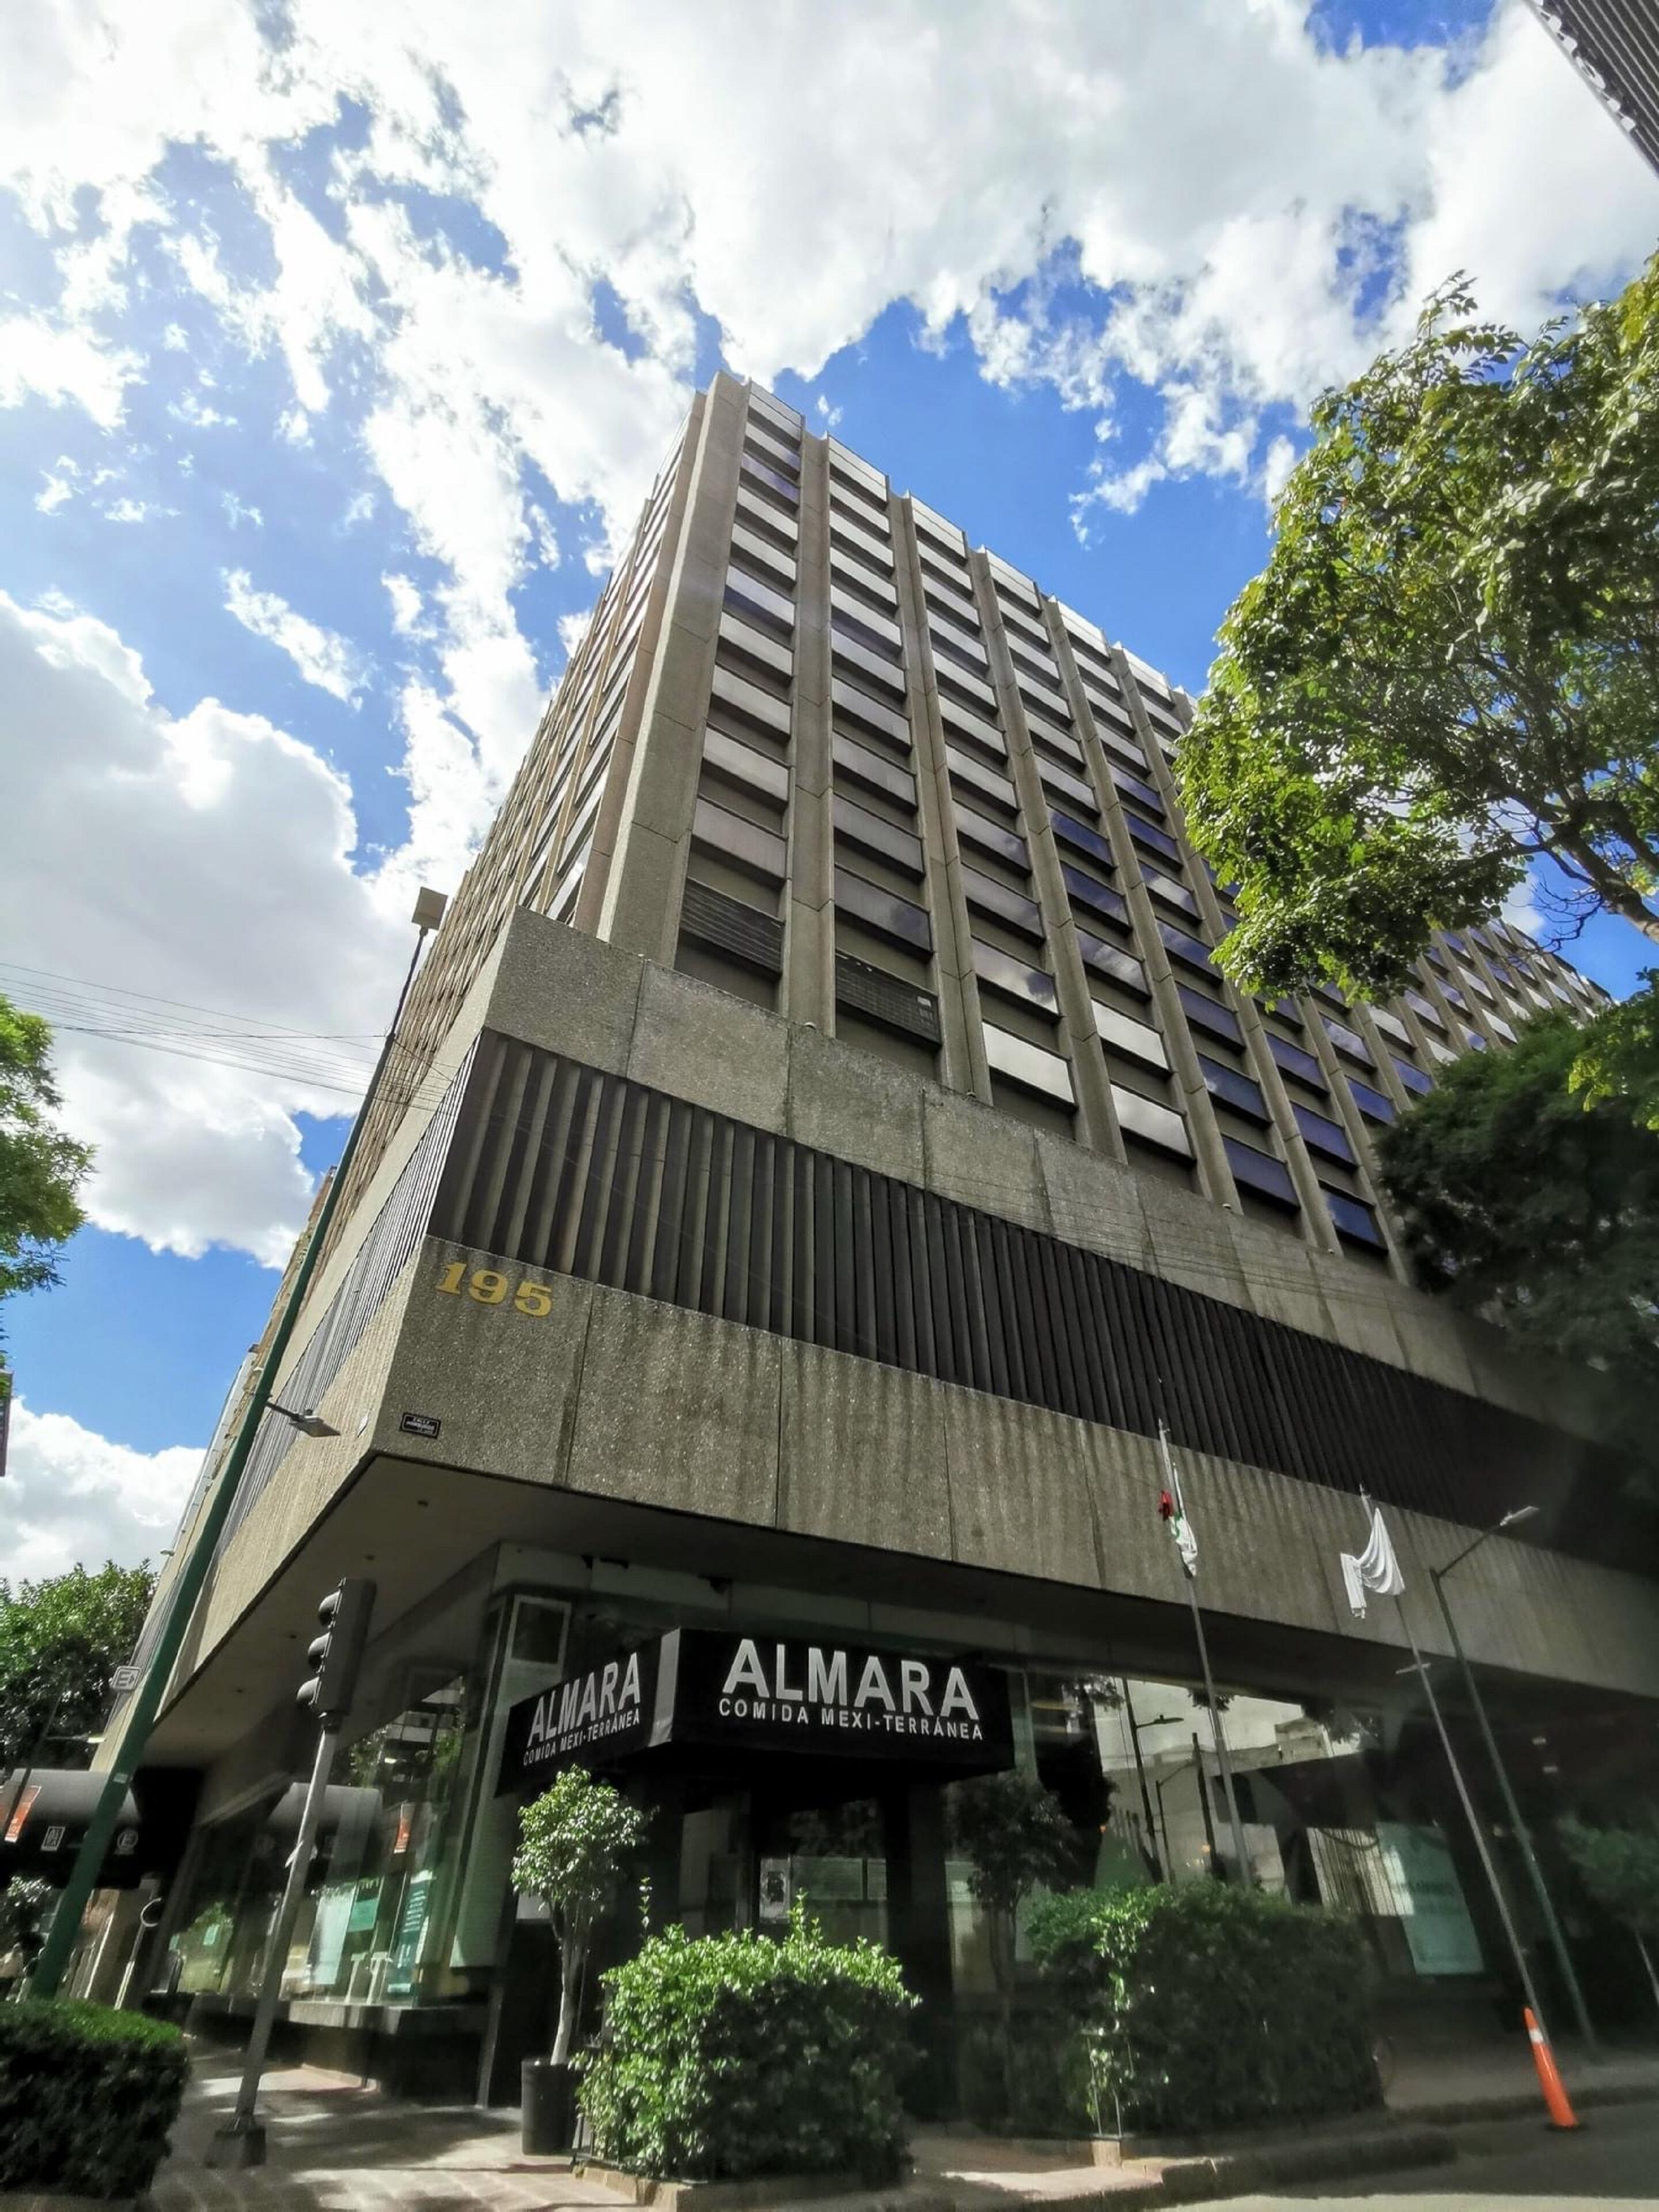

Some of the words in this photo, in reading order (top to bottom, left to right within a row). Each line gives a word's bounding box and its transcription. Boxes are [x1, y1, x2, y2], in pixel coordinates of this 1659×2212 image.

[435, 1262, 553, 1317] 195
[527, 1652, 641, 1748] ALMARA
[722, 1638, 979, 1721] ALMARA
[719, 1698, 809, 1724] COMIDA
[821, 1707, 983, 1741] MEXI-TERRÁNEA
[522, 1741, 556, 1767] COMIDA
